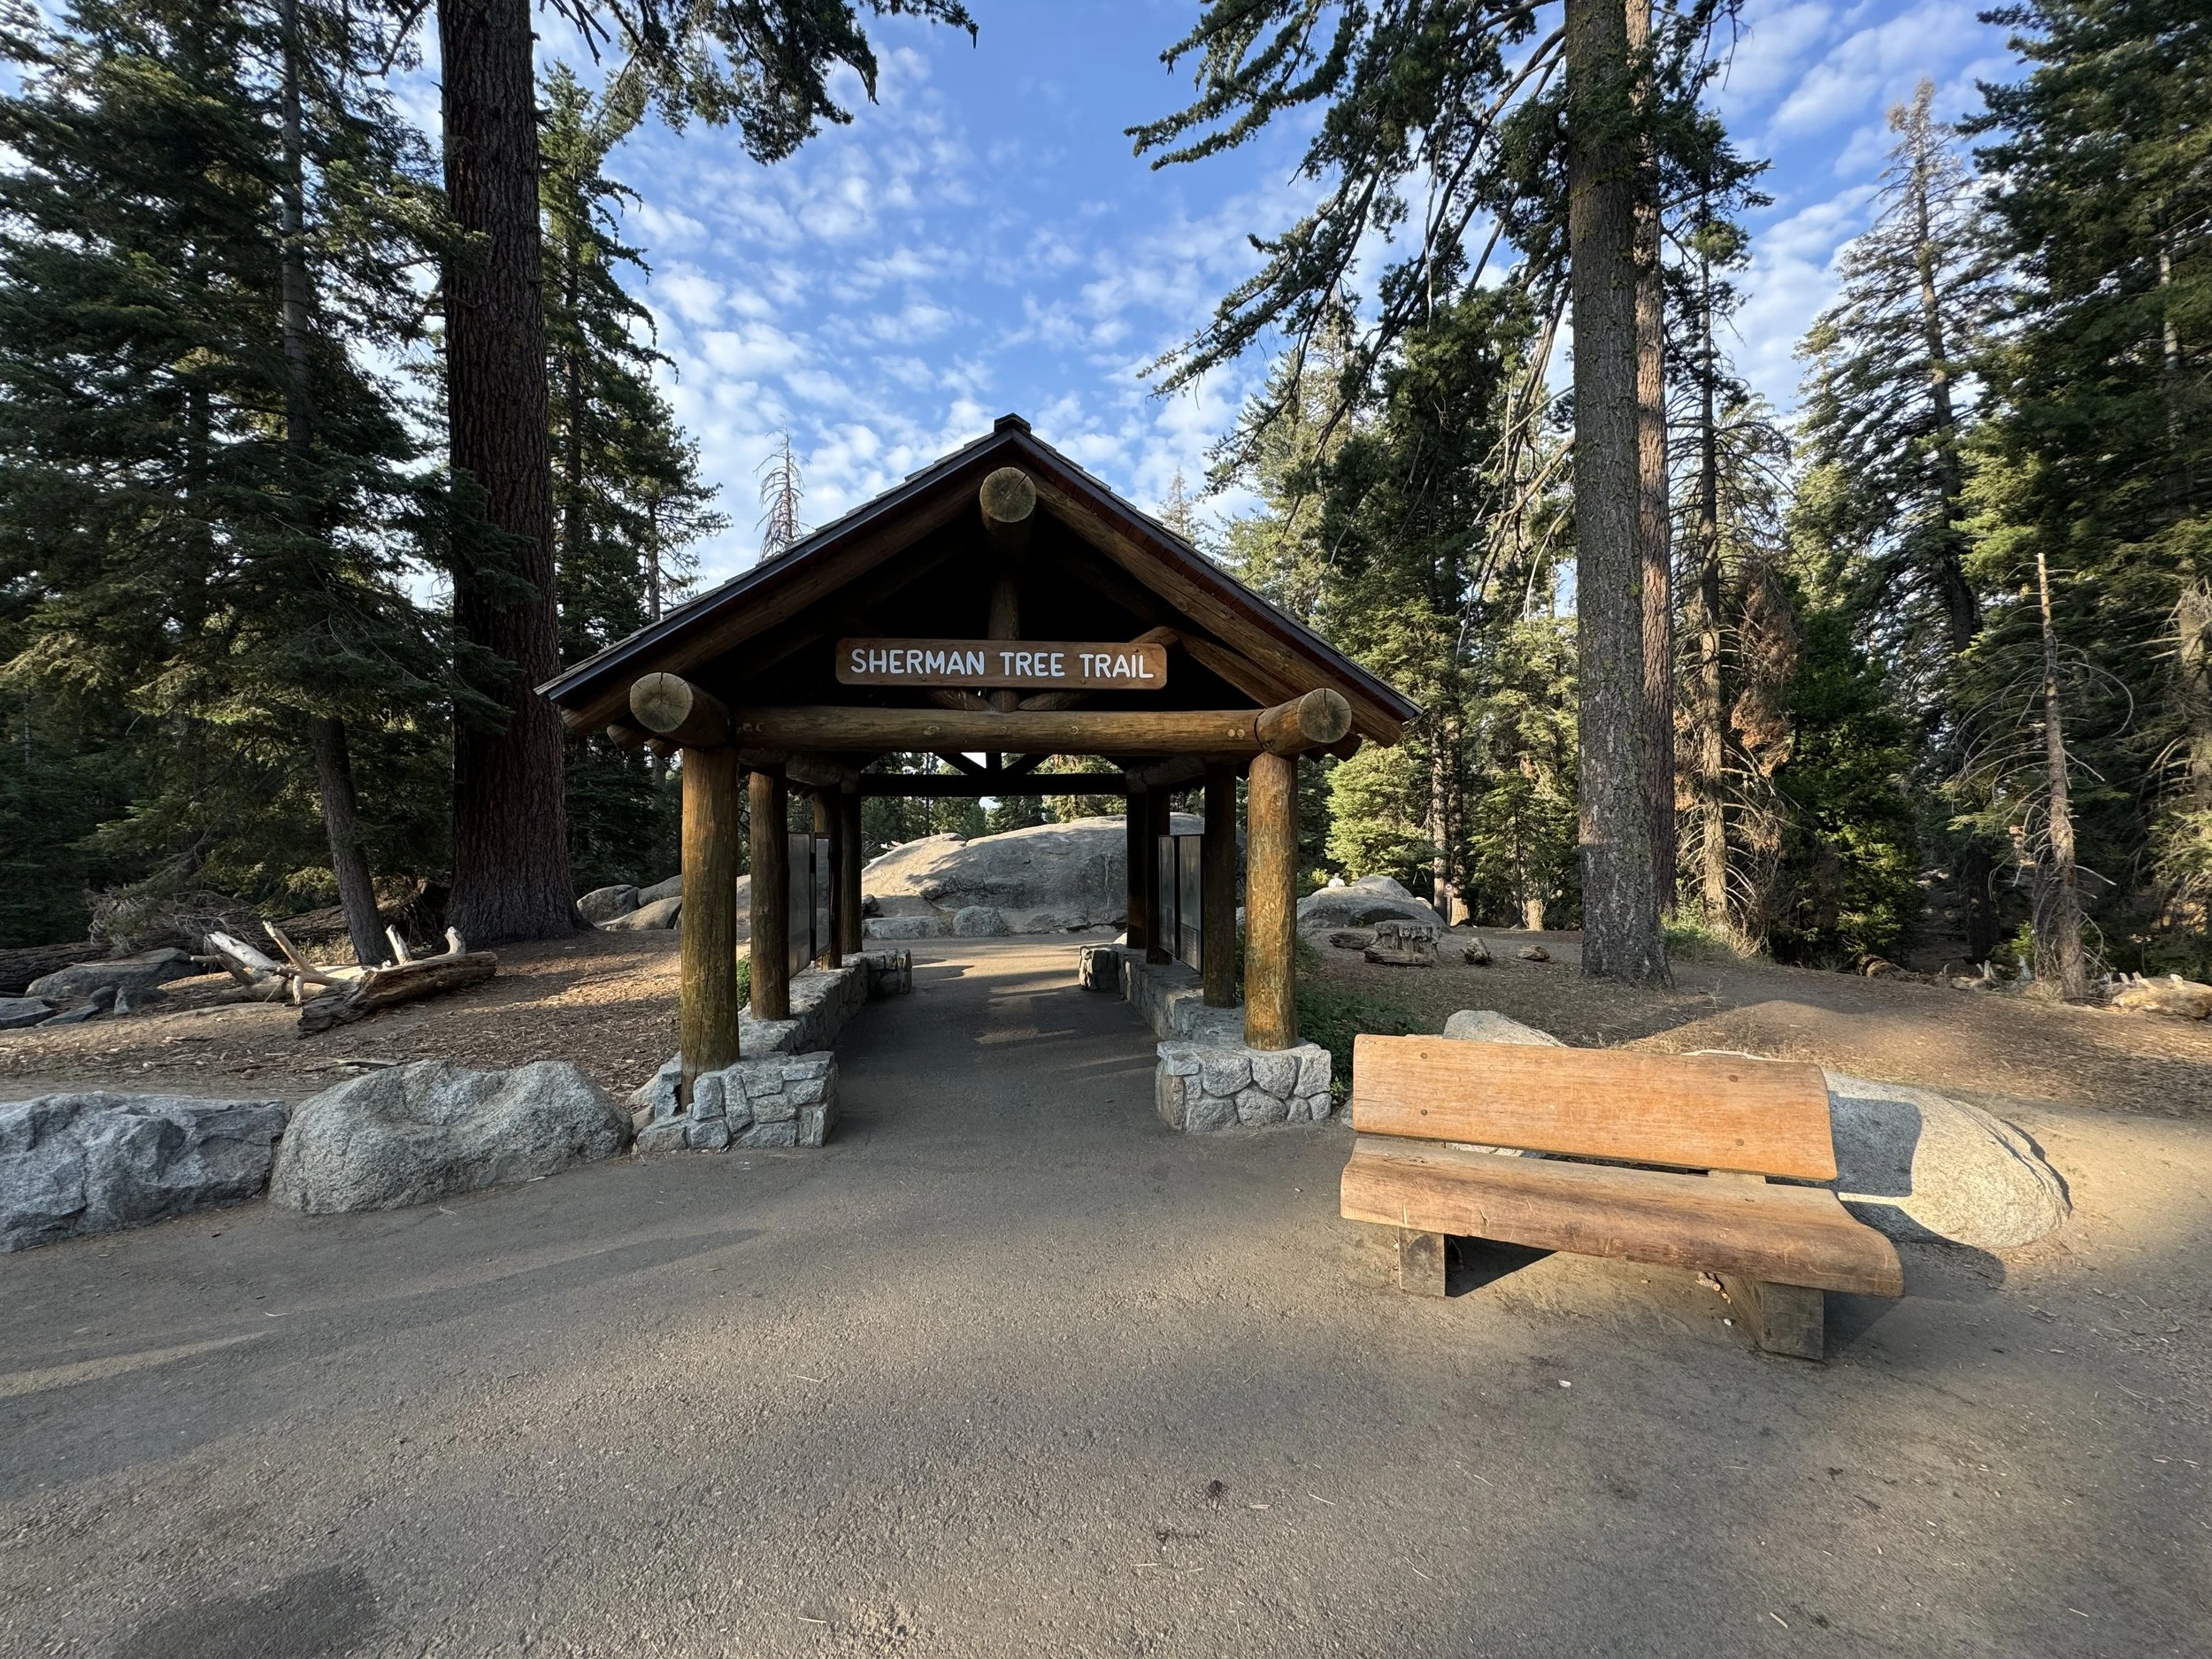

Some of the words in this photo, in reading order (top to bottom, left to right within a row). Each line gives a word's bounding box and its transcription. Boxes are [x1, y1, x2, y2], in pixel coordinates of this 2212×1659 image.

[850, 649, 986, 676] SHERMAN
[999, 651, 1066, 678] TREE
[1079, 653, 1155, 679] TRAIL
